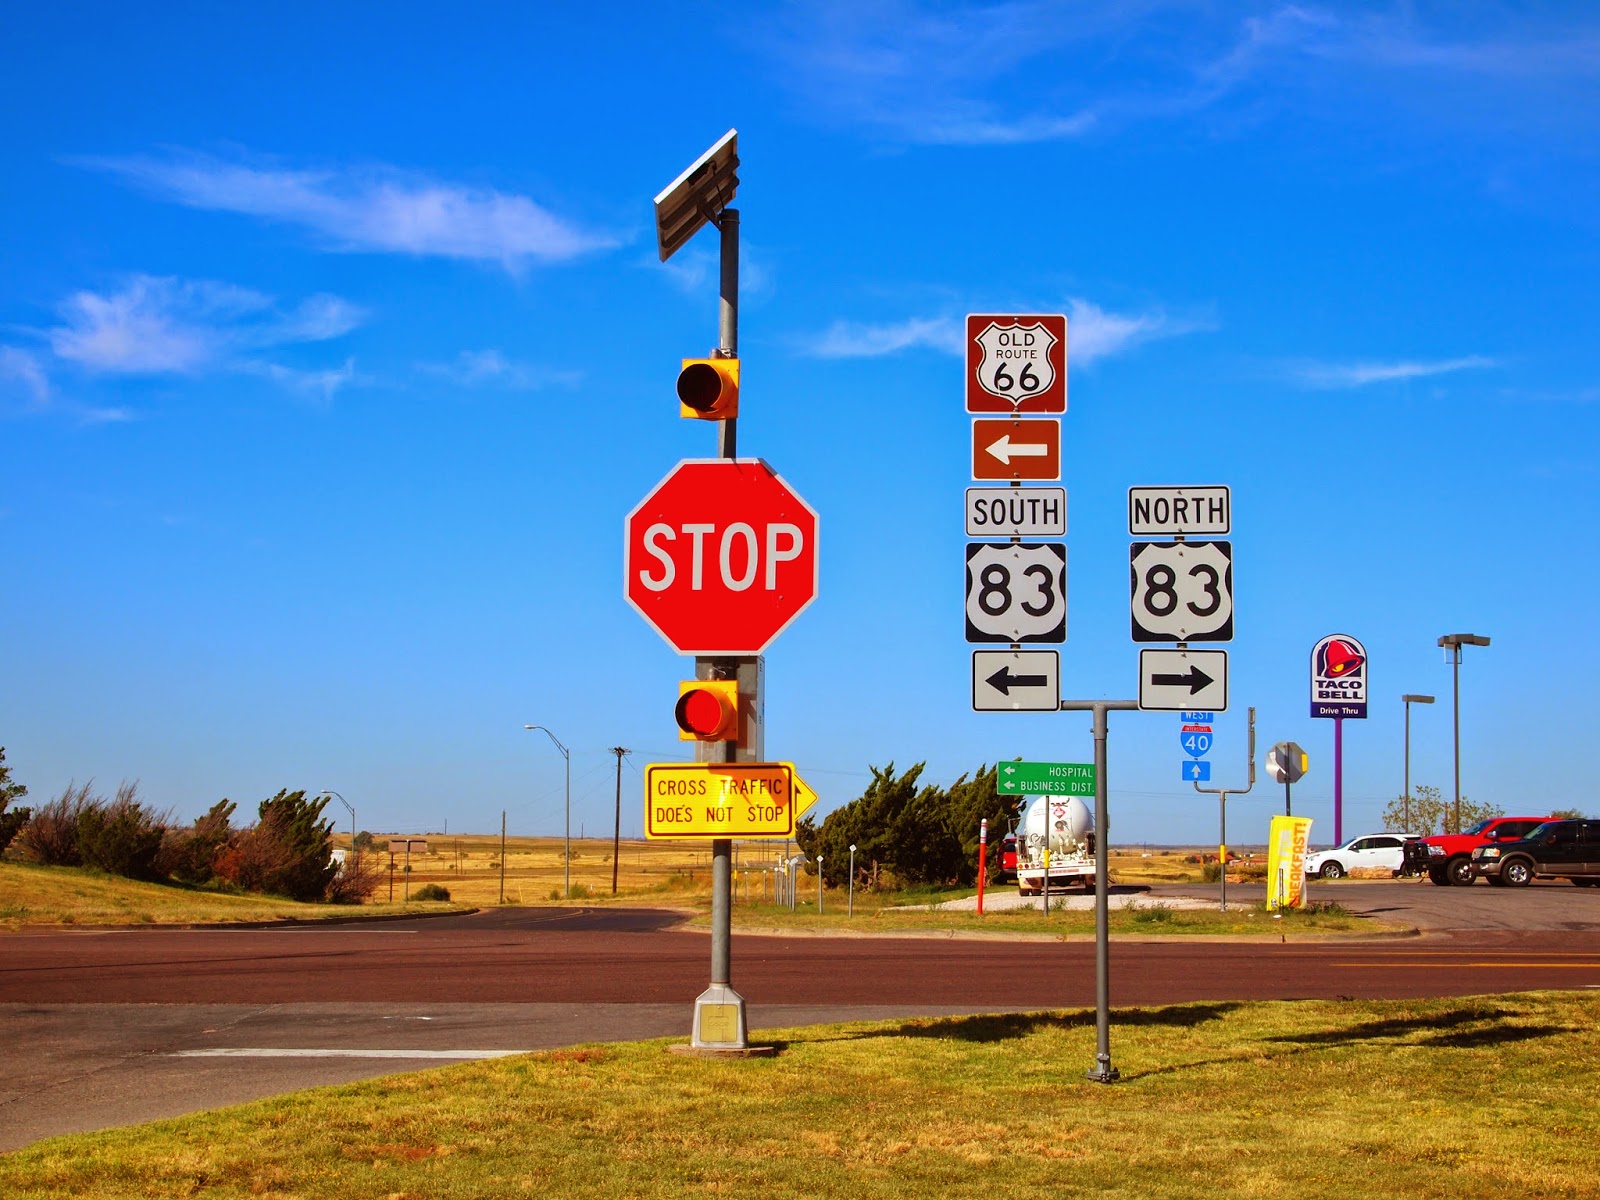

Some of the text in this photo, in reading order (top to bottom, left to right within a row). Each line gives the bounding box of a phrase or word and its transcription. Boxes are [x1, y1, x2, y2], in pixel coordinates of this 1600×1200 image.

[998, 333, 1035, 347] OLD
[996, 349, 1037, 359] ROUTE
[993, 362, 1040, 392] 66
[973, 498, 1059, 526] SOUTH
[1134, 497, 1225, 524] NORTH
[639, 522, 804, 591] STOP
[978, 563, 1055, 617] 83
[1144, 563, 1221, 617] 83
[1315, 680, 1362, 689] TACO
[1318, 690, 1363, 699] BELL
[1185, 712, 1209, 720] WEST
[1320, 706, 1359, 714] Drive Thru
[1185, 735, 1209, 751] 40
[1049, 767, 1093, 778] HOSPITAL
[658, 779, 782, 795] CROSS TRAFFIC
[1020, 781, 1095, 793] BUSINESS DIST.
[656, 806, 784, 822] DOES NOT STOP
